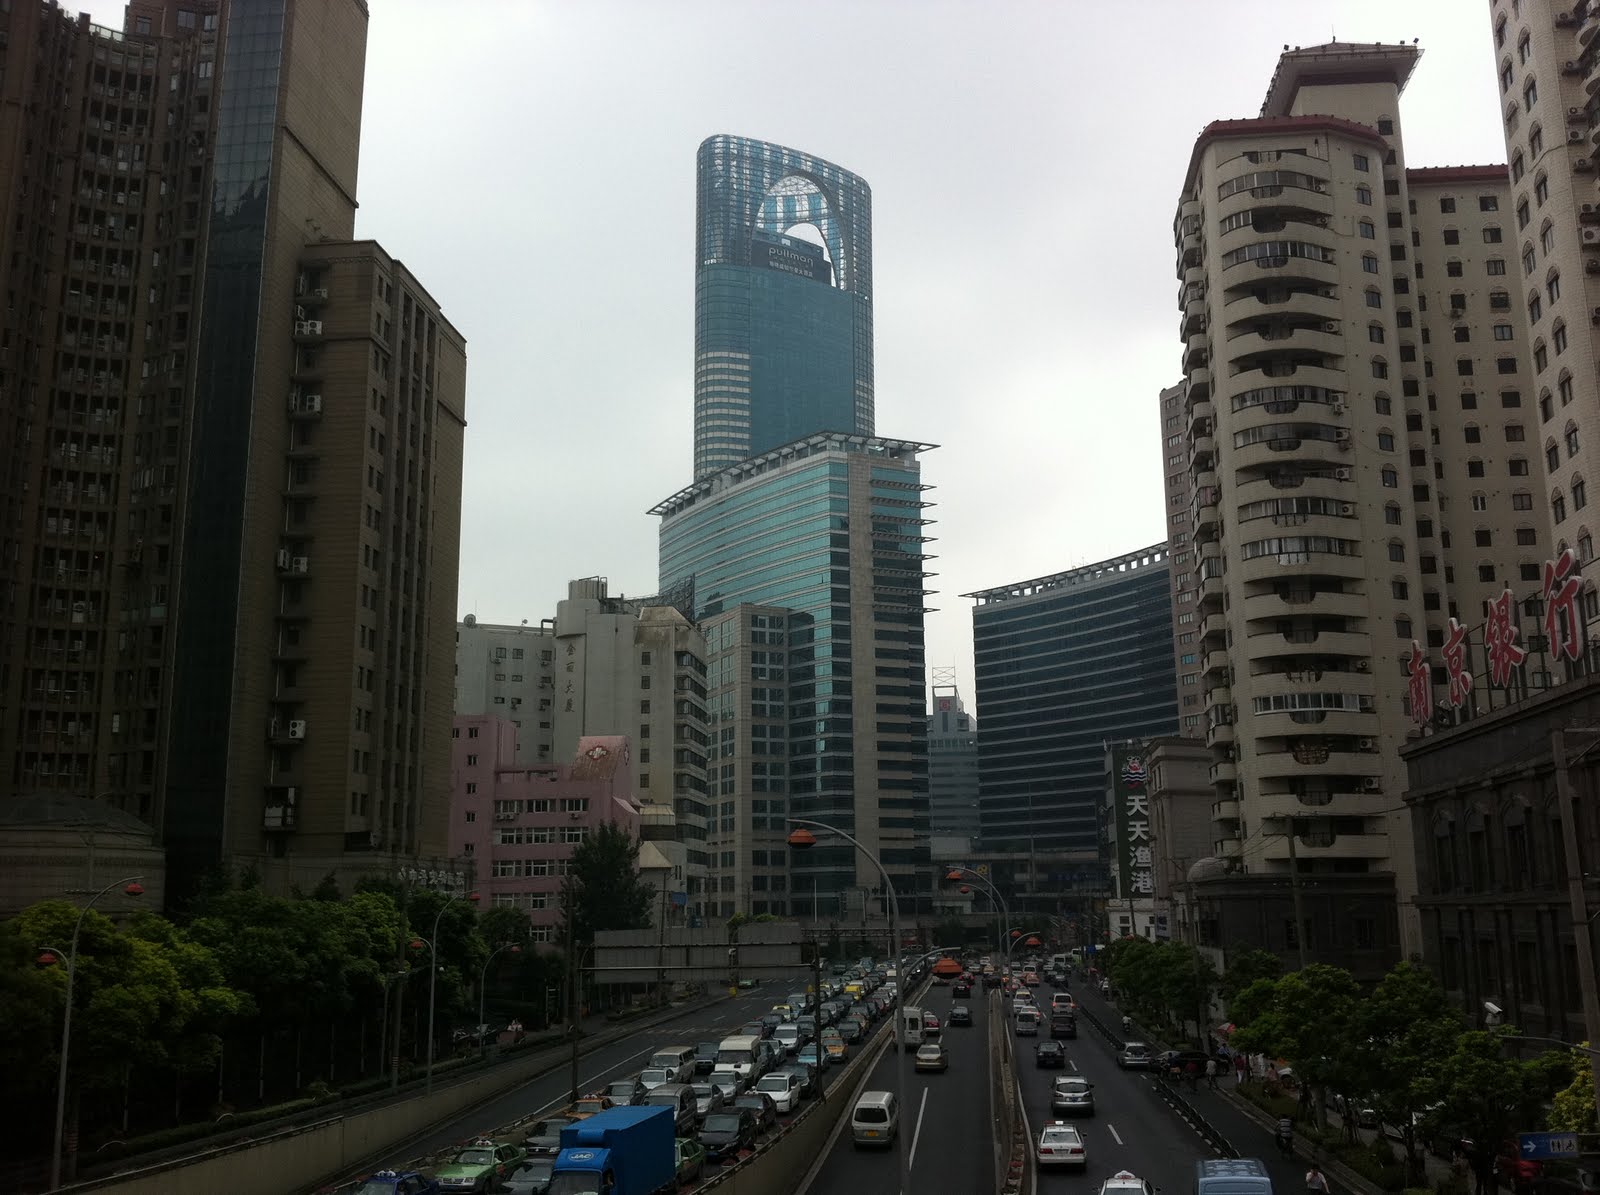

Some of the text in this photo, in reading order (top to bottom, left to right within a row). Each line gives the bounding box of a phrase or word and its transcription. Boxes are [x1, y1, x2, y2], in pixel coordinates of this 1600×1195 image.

[769, 247, 813, 268] pullman
[1126, 794, 1153, 894] 天天渔港
[570, 1152, 592, 1160] JAC
